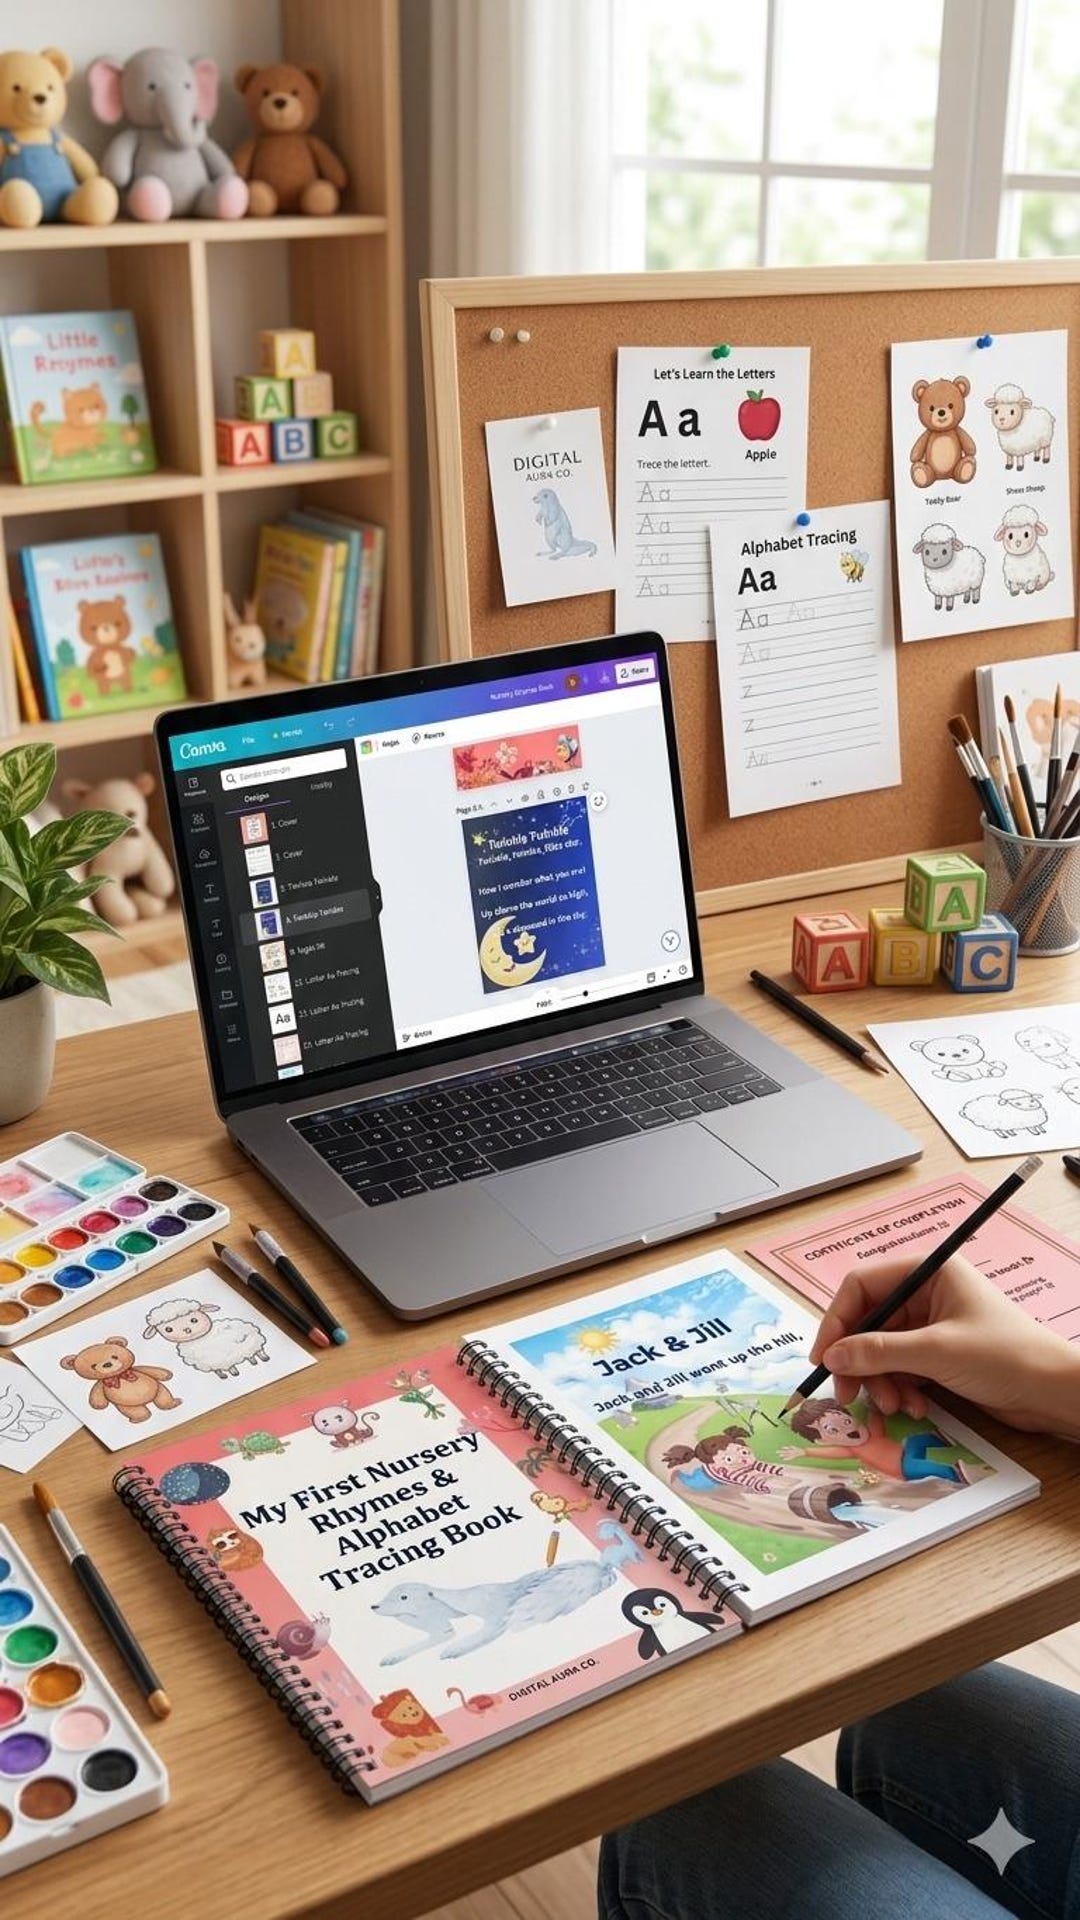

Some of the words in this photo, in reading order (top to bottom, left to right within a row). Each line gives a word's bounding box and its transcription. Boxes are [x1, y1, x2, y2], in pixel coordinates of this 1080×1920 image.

[654, 368, 680, 380] Let's
[683, 368, 713, 380] Learn
[717, 368, 735, 379] the
[738, 368, 776, 379] Letters
[261, 387, 283, 413] A
[241, 431, 262, 458] A
[284, 428, 304, 455] B
[329, 424, 349, 450] C
[513, 450, 582, 471] DIGITAL
[664, 459, 678, 469] the
[745, 449, 777, 462] Apple
[741, 536, 803, 557] Alphabet
[806, 529, 857, 546] Tracing
[738, 567, 777, 595] Aa
[938, 887, 971, 922] A
[821, 946, 855, 981] A
[890, 941, 919, 976] B
[971, 946, 1003, 981] C
[276, 1014, 291, 1025] Aa
[592, 1345, 665, 1376] Jack
[664, 1335, 690, 1352] &
[687, 1318, 732, 1344] Jill
[728, 1352, 748, 1365] up
[240, 1501, 288, 1530] My
[290, 1474, 366, 1510] First
[364, 1432, 480, 1483] Nursery
[308, 1480, 429, 1534] Rhymes
[431, 1469, 460, 1488] &
[337, 1494, 471, 1557] Alphabet
[319, 1537, 446, 1591] Tracing
[440, 1504, 524, 1545] Book
